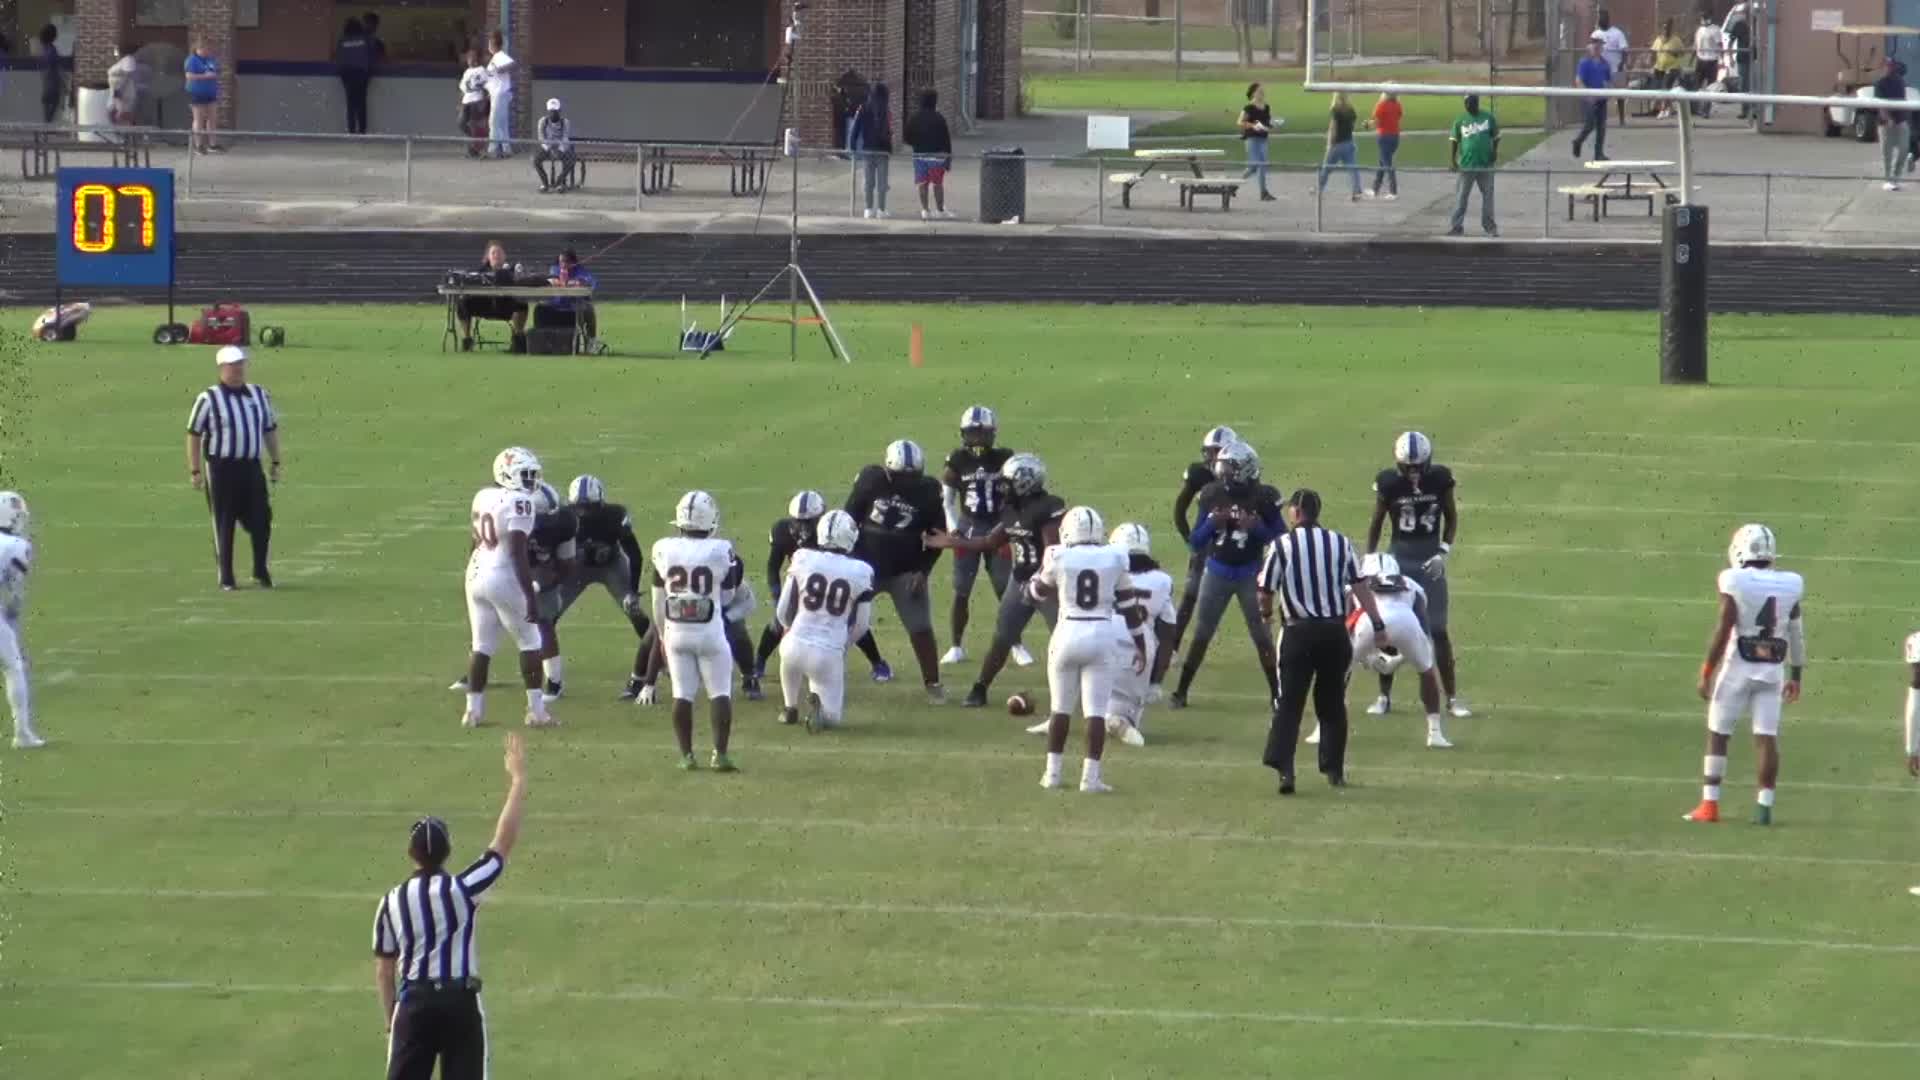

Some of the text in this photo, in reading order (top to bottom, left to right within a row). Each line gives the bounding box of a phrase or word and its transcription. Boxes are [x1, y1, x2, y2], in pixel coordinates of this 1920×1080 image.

[74, 184, 153, 252] 07
[515, 500, 532, 515] 50
[667, 565, 713, 596] 20
[803, 572, 850, 617] 90
[1076, 568, 1099, 611] 8
[1754, 595, 1777, 640] 4
